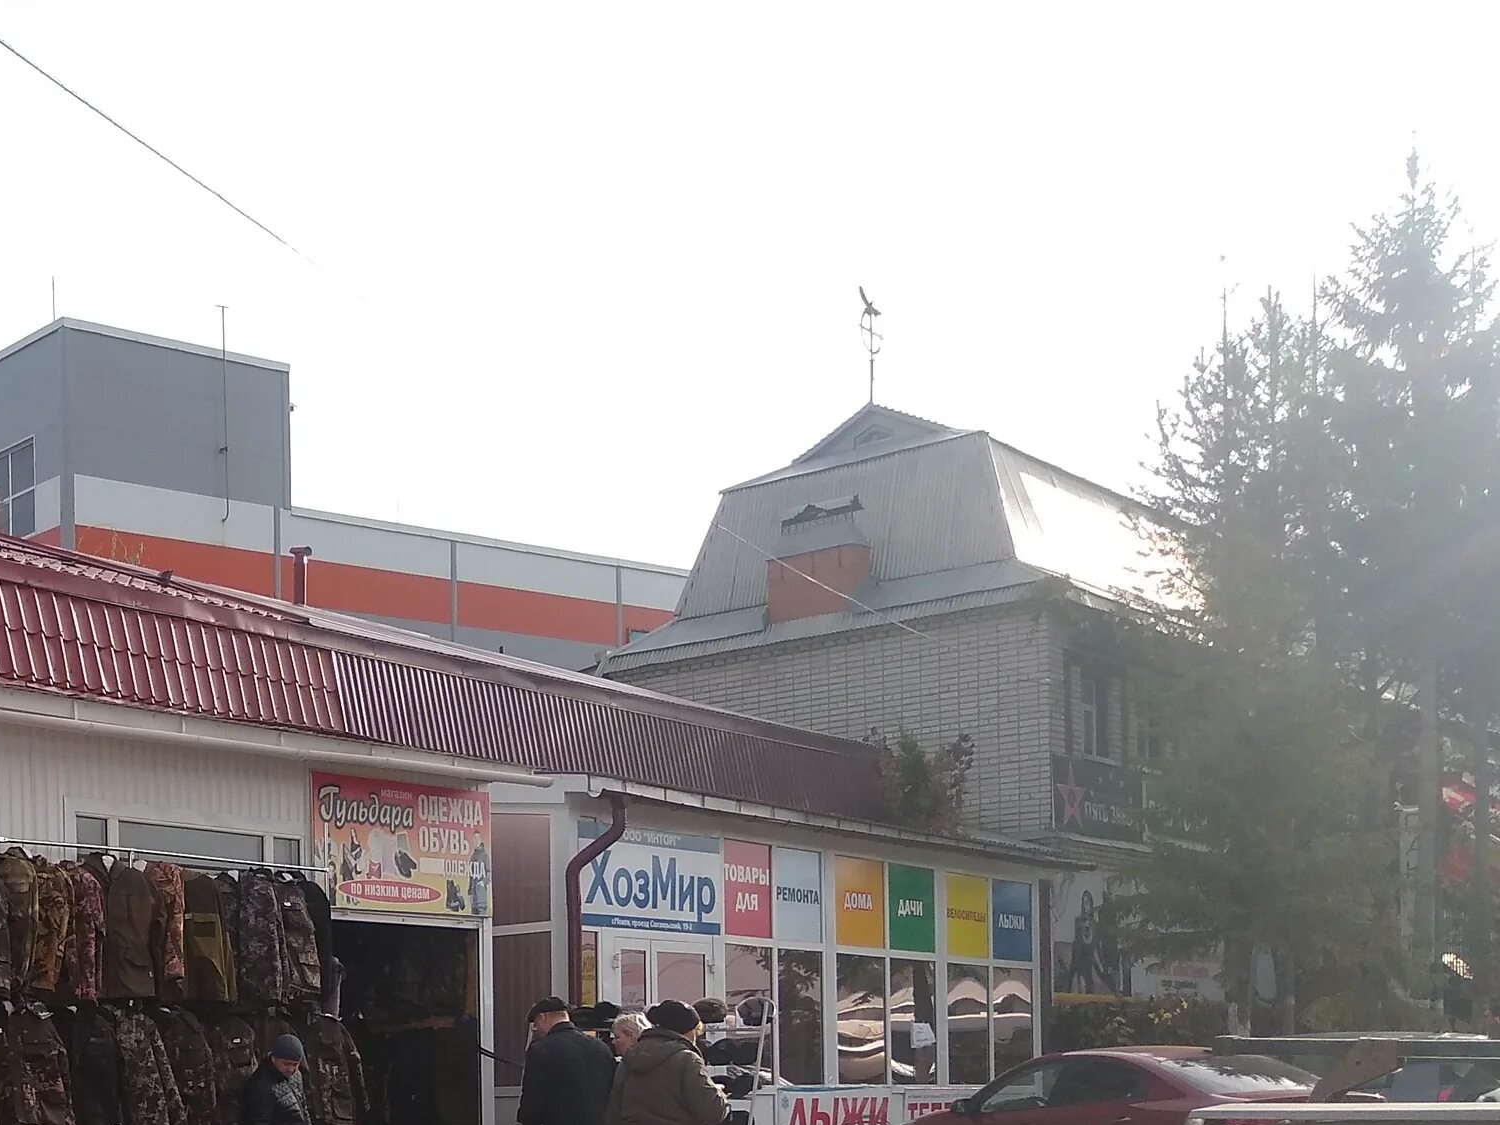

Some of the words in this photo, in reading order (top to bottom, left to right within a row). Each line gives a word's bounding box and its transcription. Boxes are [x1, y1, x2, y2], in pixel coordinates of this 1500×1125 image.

[380, 787, 413, 800] магазин
[318, 784, 414, 833] Гульдара
[417, 793, 484, 828] ОДЕЖДА
[418, 826, 470, 856] ОБУВЬ
[445, 860, 487, 879] ОДЕЖДА
[724, 863, 770, 886] ТОВАРЫ
[350, 882, 363, 896] по
[364, 884, 400, 898] низким
[401, 887, 431, 901] ценам
[584, 850, 716, 923] ХозМир
[776, 885, 820, 905] РЕМОНТА
[735, 892, 759, 913] ДЛЯ
[843, 891, 873, 911] ДОМА
[897, 899, 924, 918] ДАЧИ
[946, 907, 987, 923] ВЕЛОСИПЕДЫ
[997, 913, 1025, 931] ЛЫЖИ
